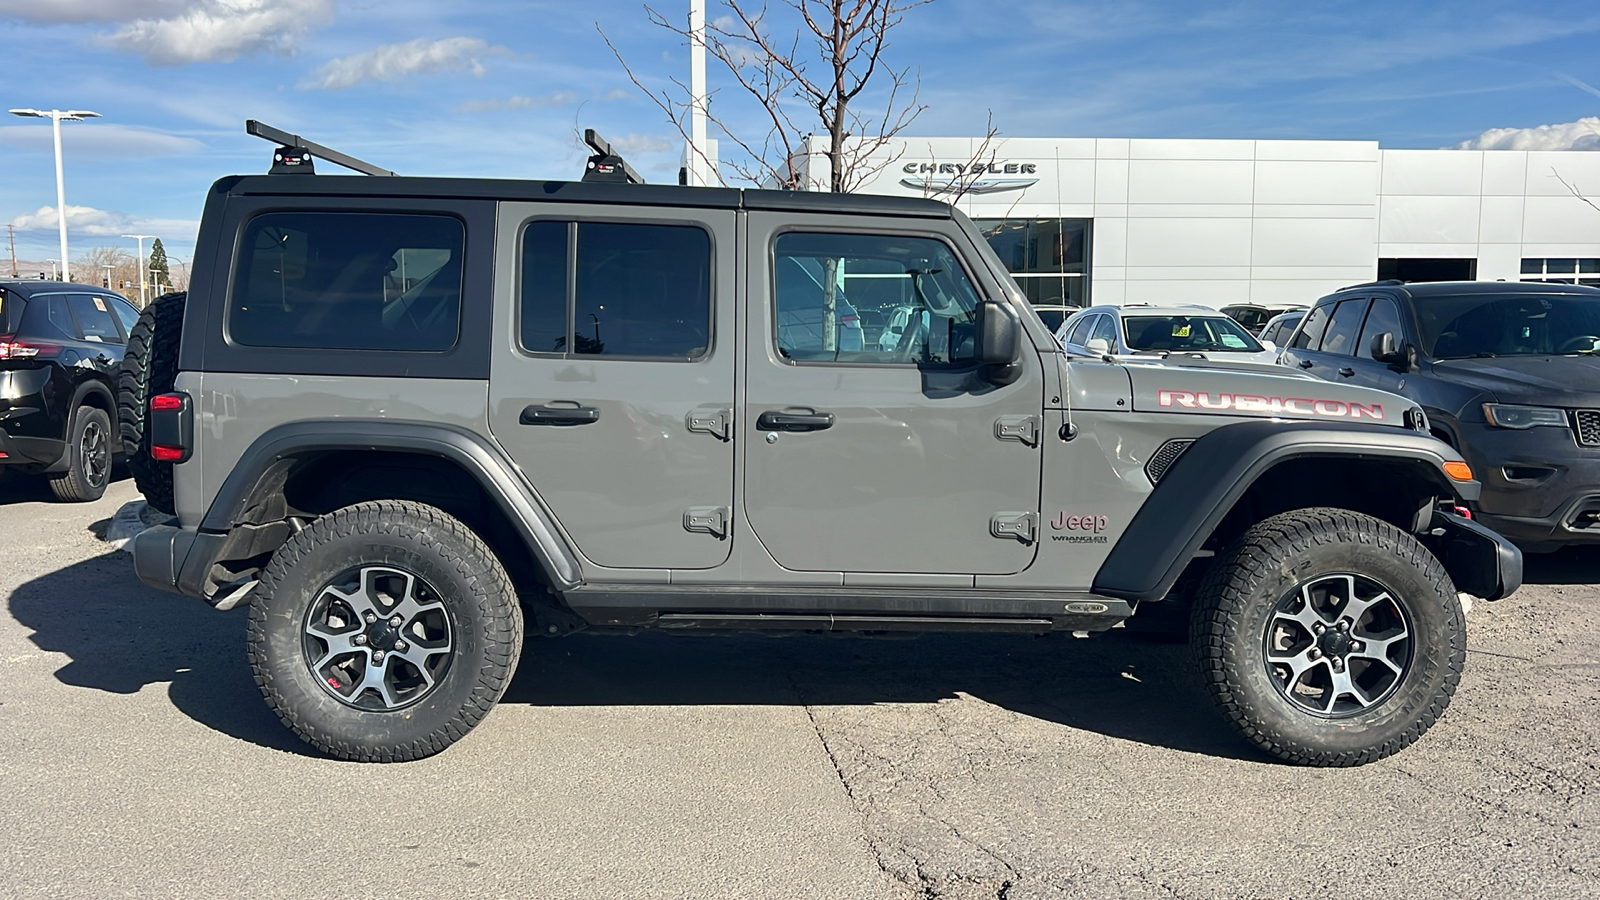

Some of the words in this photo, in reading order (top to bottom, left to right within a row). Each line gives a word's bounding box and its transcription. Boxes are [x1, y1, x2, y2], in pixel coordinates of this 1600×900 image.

[902, 162, 1037, 174] CHRYSLER
[1158, 389, 1384, 420] RUBICON
[1050, 510, 1109, 534] Jeep
[364, 542, 469, 607] TERRAMAX
[1277, 560, 1313, 586] AT2
